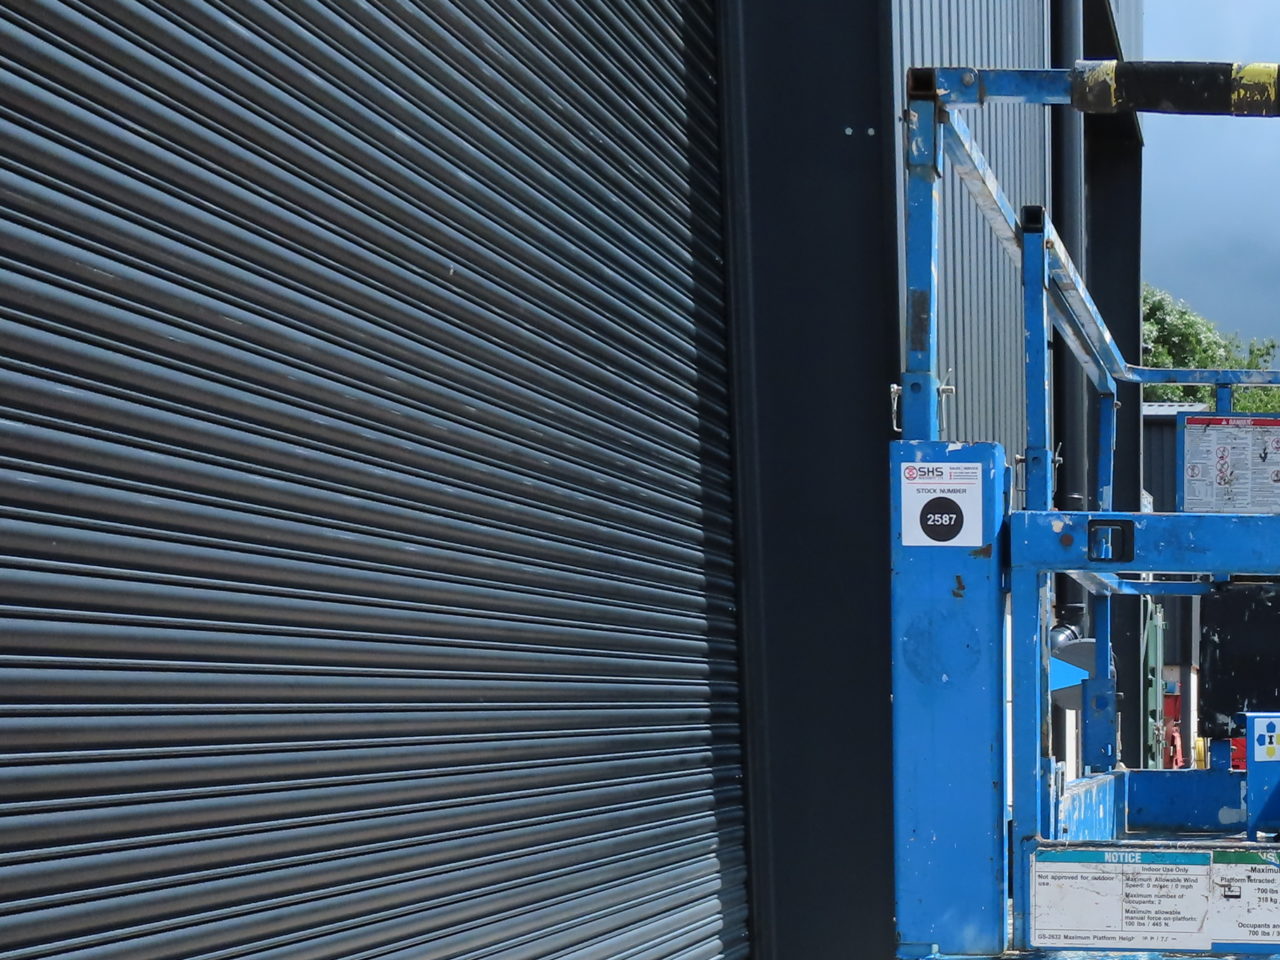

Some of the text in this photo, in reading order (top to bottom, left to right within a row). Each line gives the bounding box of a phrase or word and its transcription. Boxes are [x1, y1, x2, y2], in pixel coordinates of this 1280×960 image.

[918, 466, 944, 477] SHS
[927, 514, 956, 525] 2587
[1104, 852, 1142, 863] NOTICE
[1238, 922, 1270, 930] Occupants
